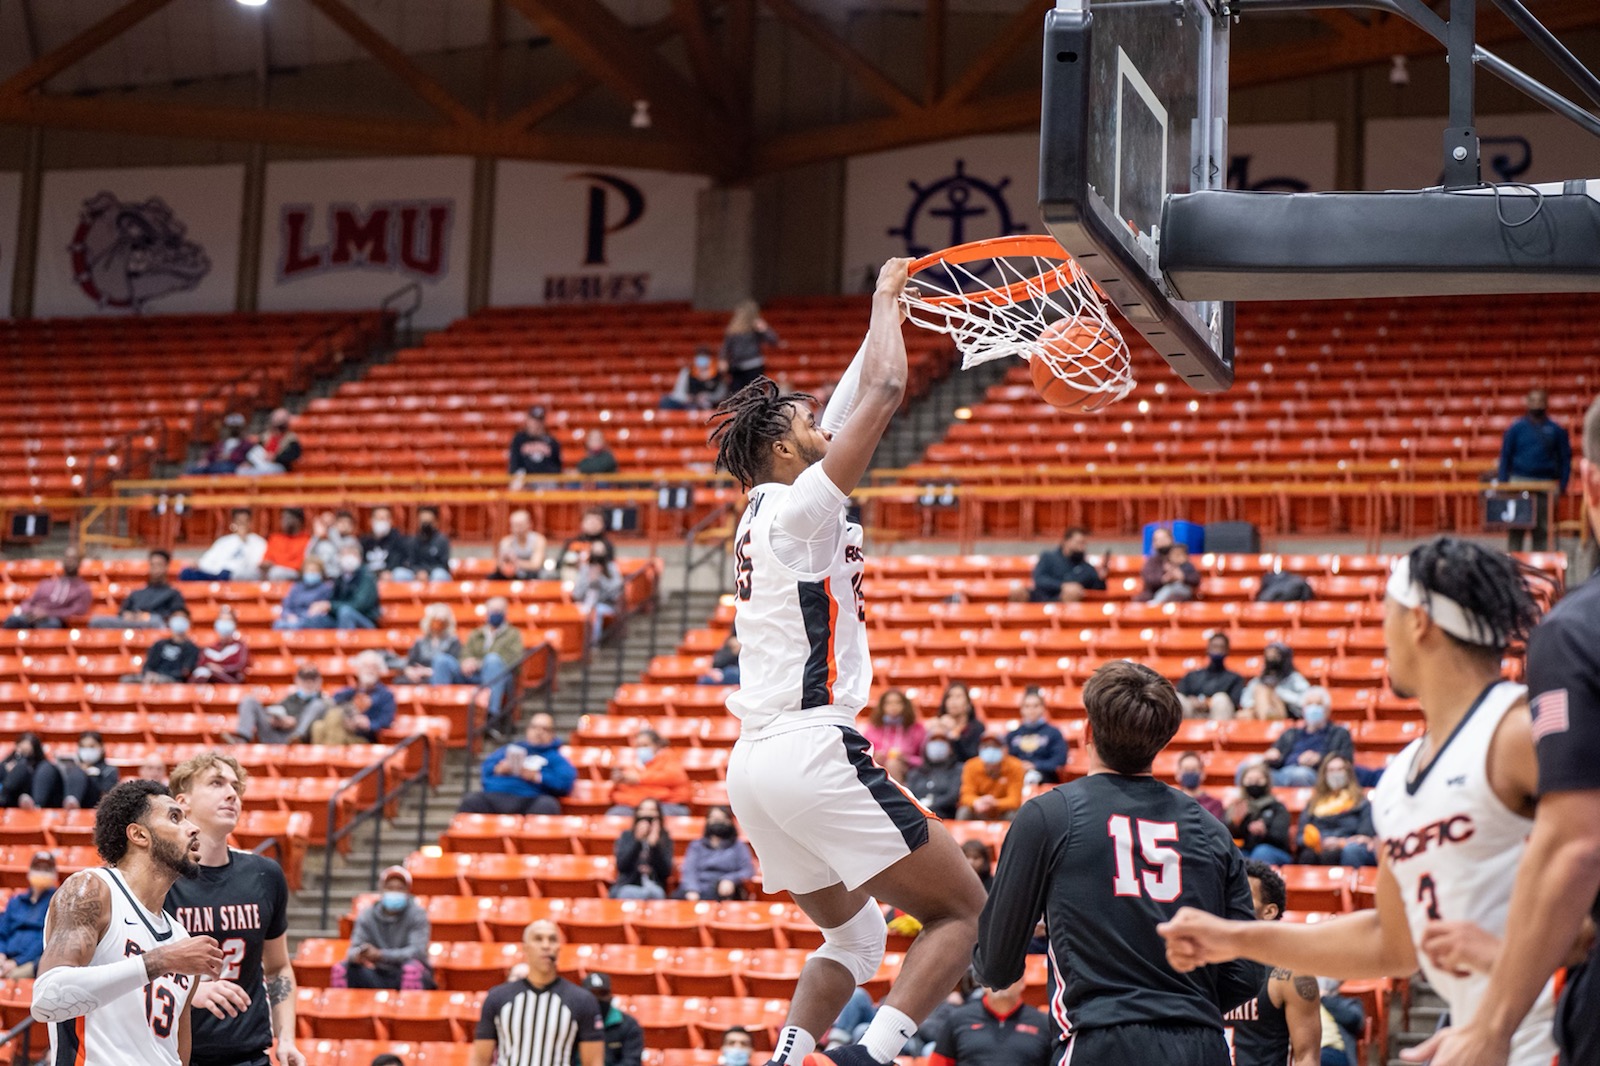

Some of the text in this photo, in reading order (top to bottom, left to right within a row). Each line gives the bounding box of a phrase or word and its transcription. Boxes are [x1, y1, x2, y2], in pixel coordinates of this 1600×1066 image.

[278, 202, 454, 282] LMU
[564, 171, 646, 266] P
[1501, 499, 1516, 523] J
[1107, 813, 1183, 903] 15
[175, 904, 261, 932] STAN STATE
[143, 981, 176, 1039] 13
